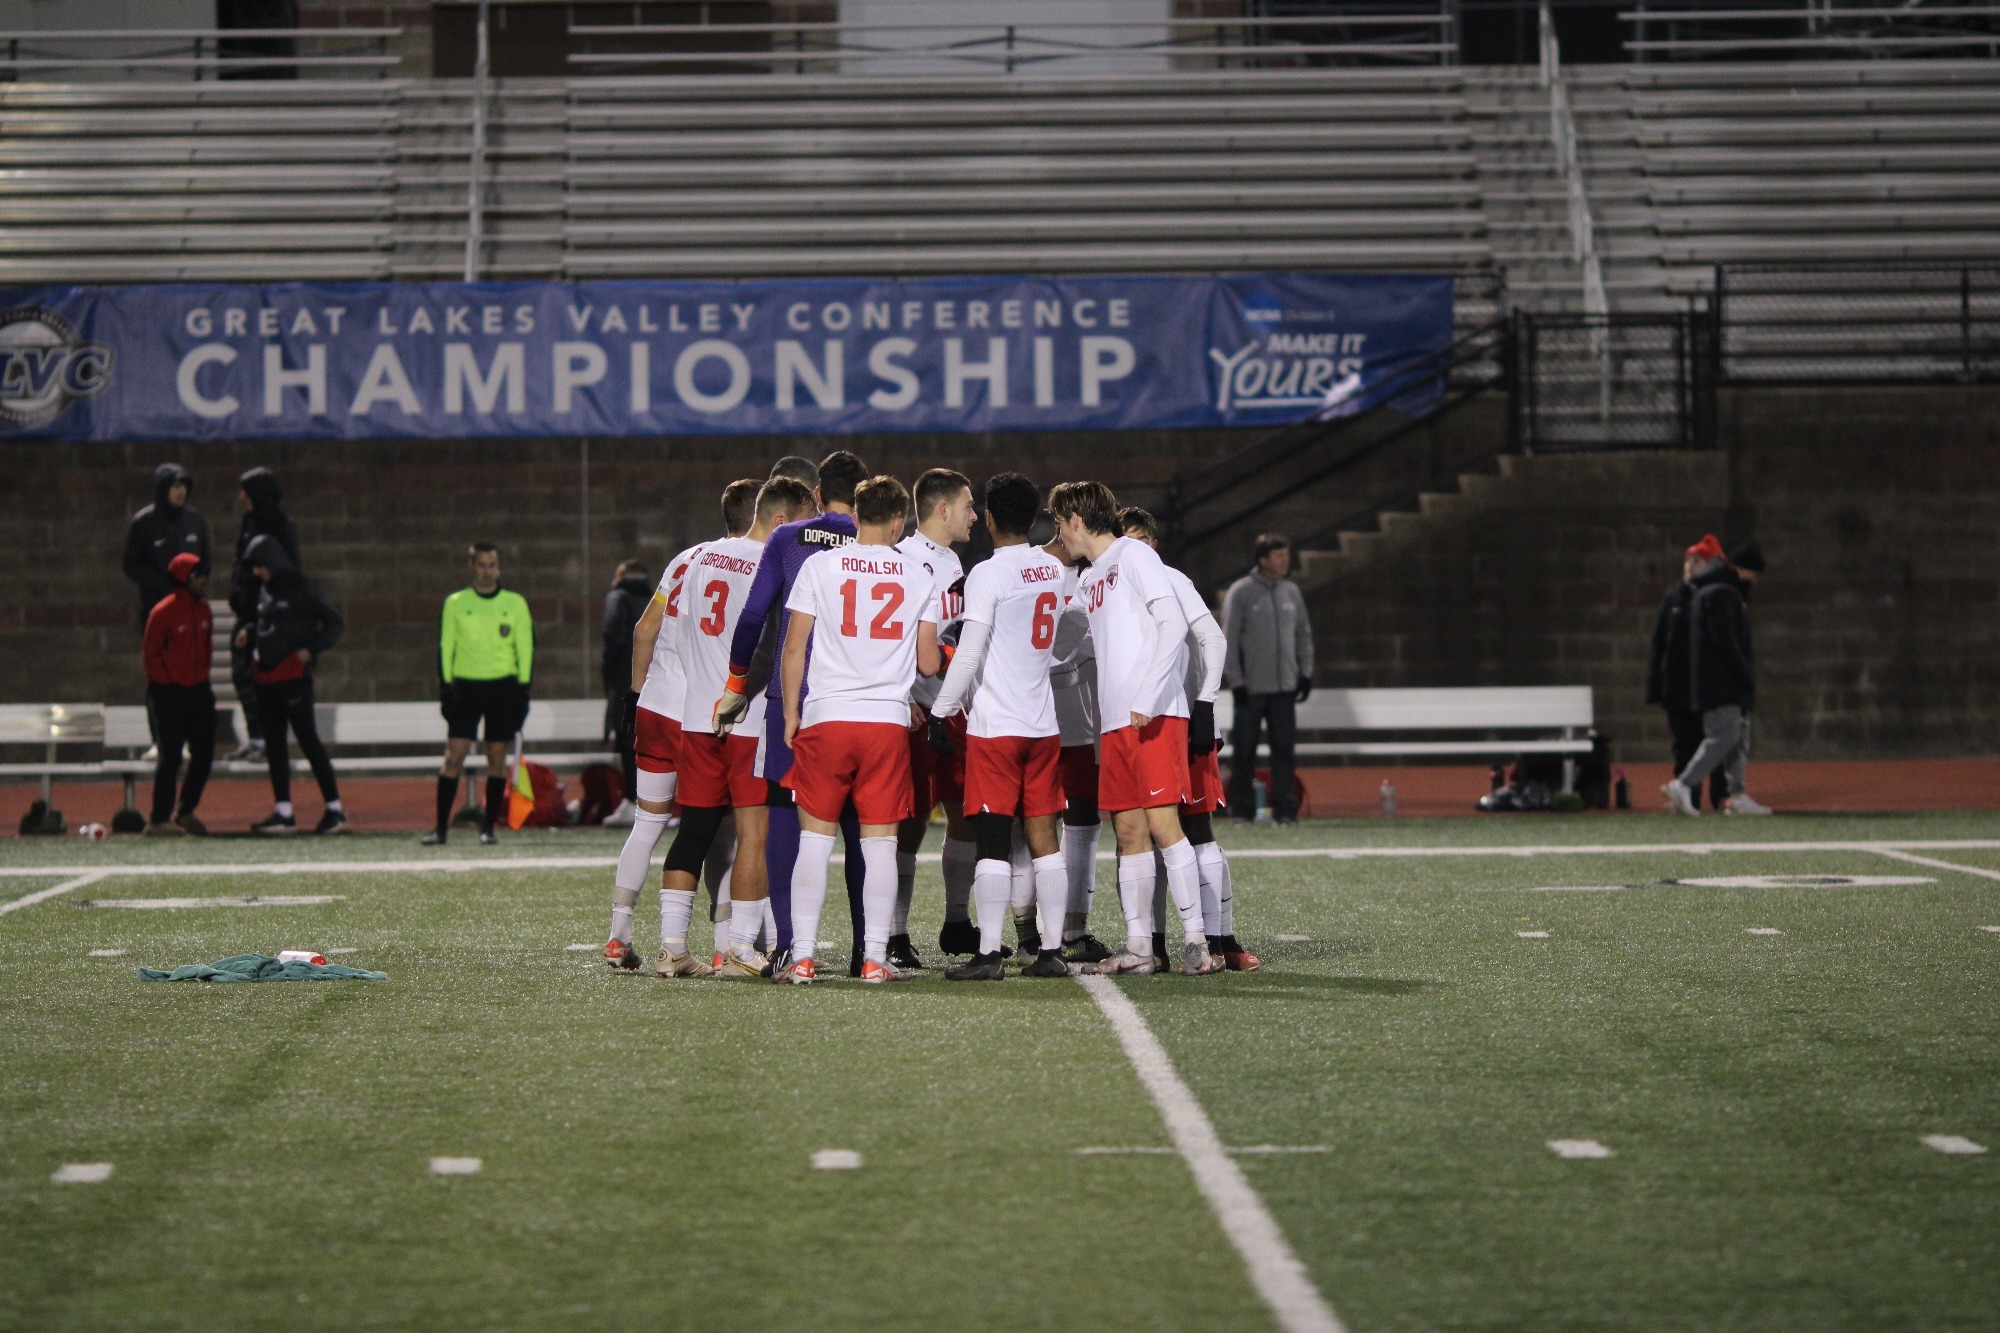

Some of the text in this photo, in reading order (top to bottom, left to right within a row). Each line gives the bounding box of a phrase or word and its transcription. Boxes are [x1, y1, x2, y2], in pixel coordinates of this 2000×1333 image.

[185, 299, 1131, 337] GREAT LAKES VALLEY CONFERENCE
[1266, 333, 1366, 353] MAKE IT
[175, 336, 1136, 418] CHAMPIONSHIP
[841, 557, 904, 575] ROGALSKI
[1020, 564, 1061, 584] HENEGAR
[699, 579, 730, 637] 3
[839, 578, 905, 640] 12
[1088, 578, 1105, 614] 30
[1031, 591, 1058, 650] 6
